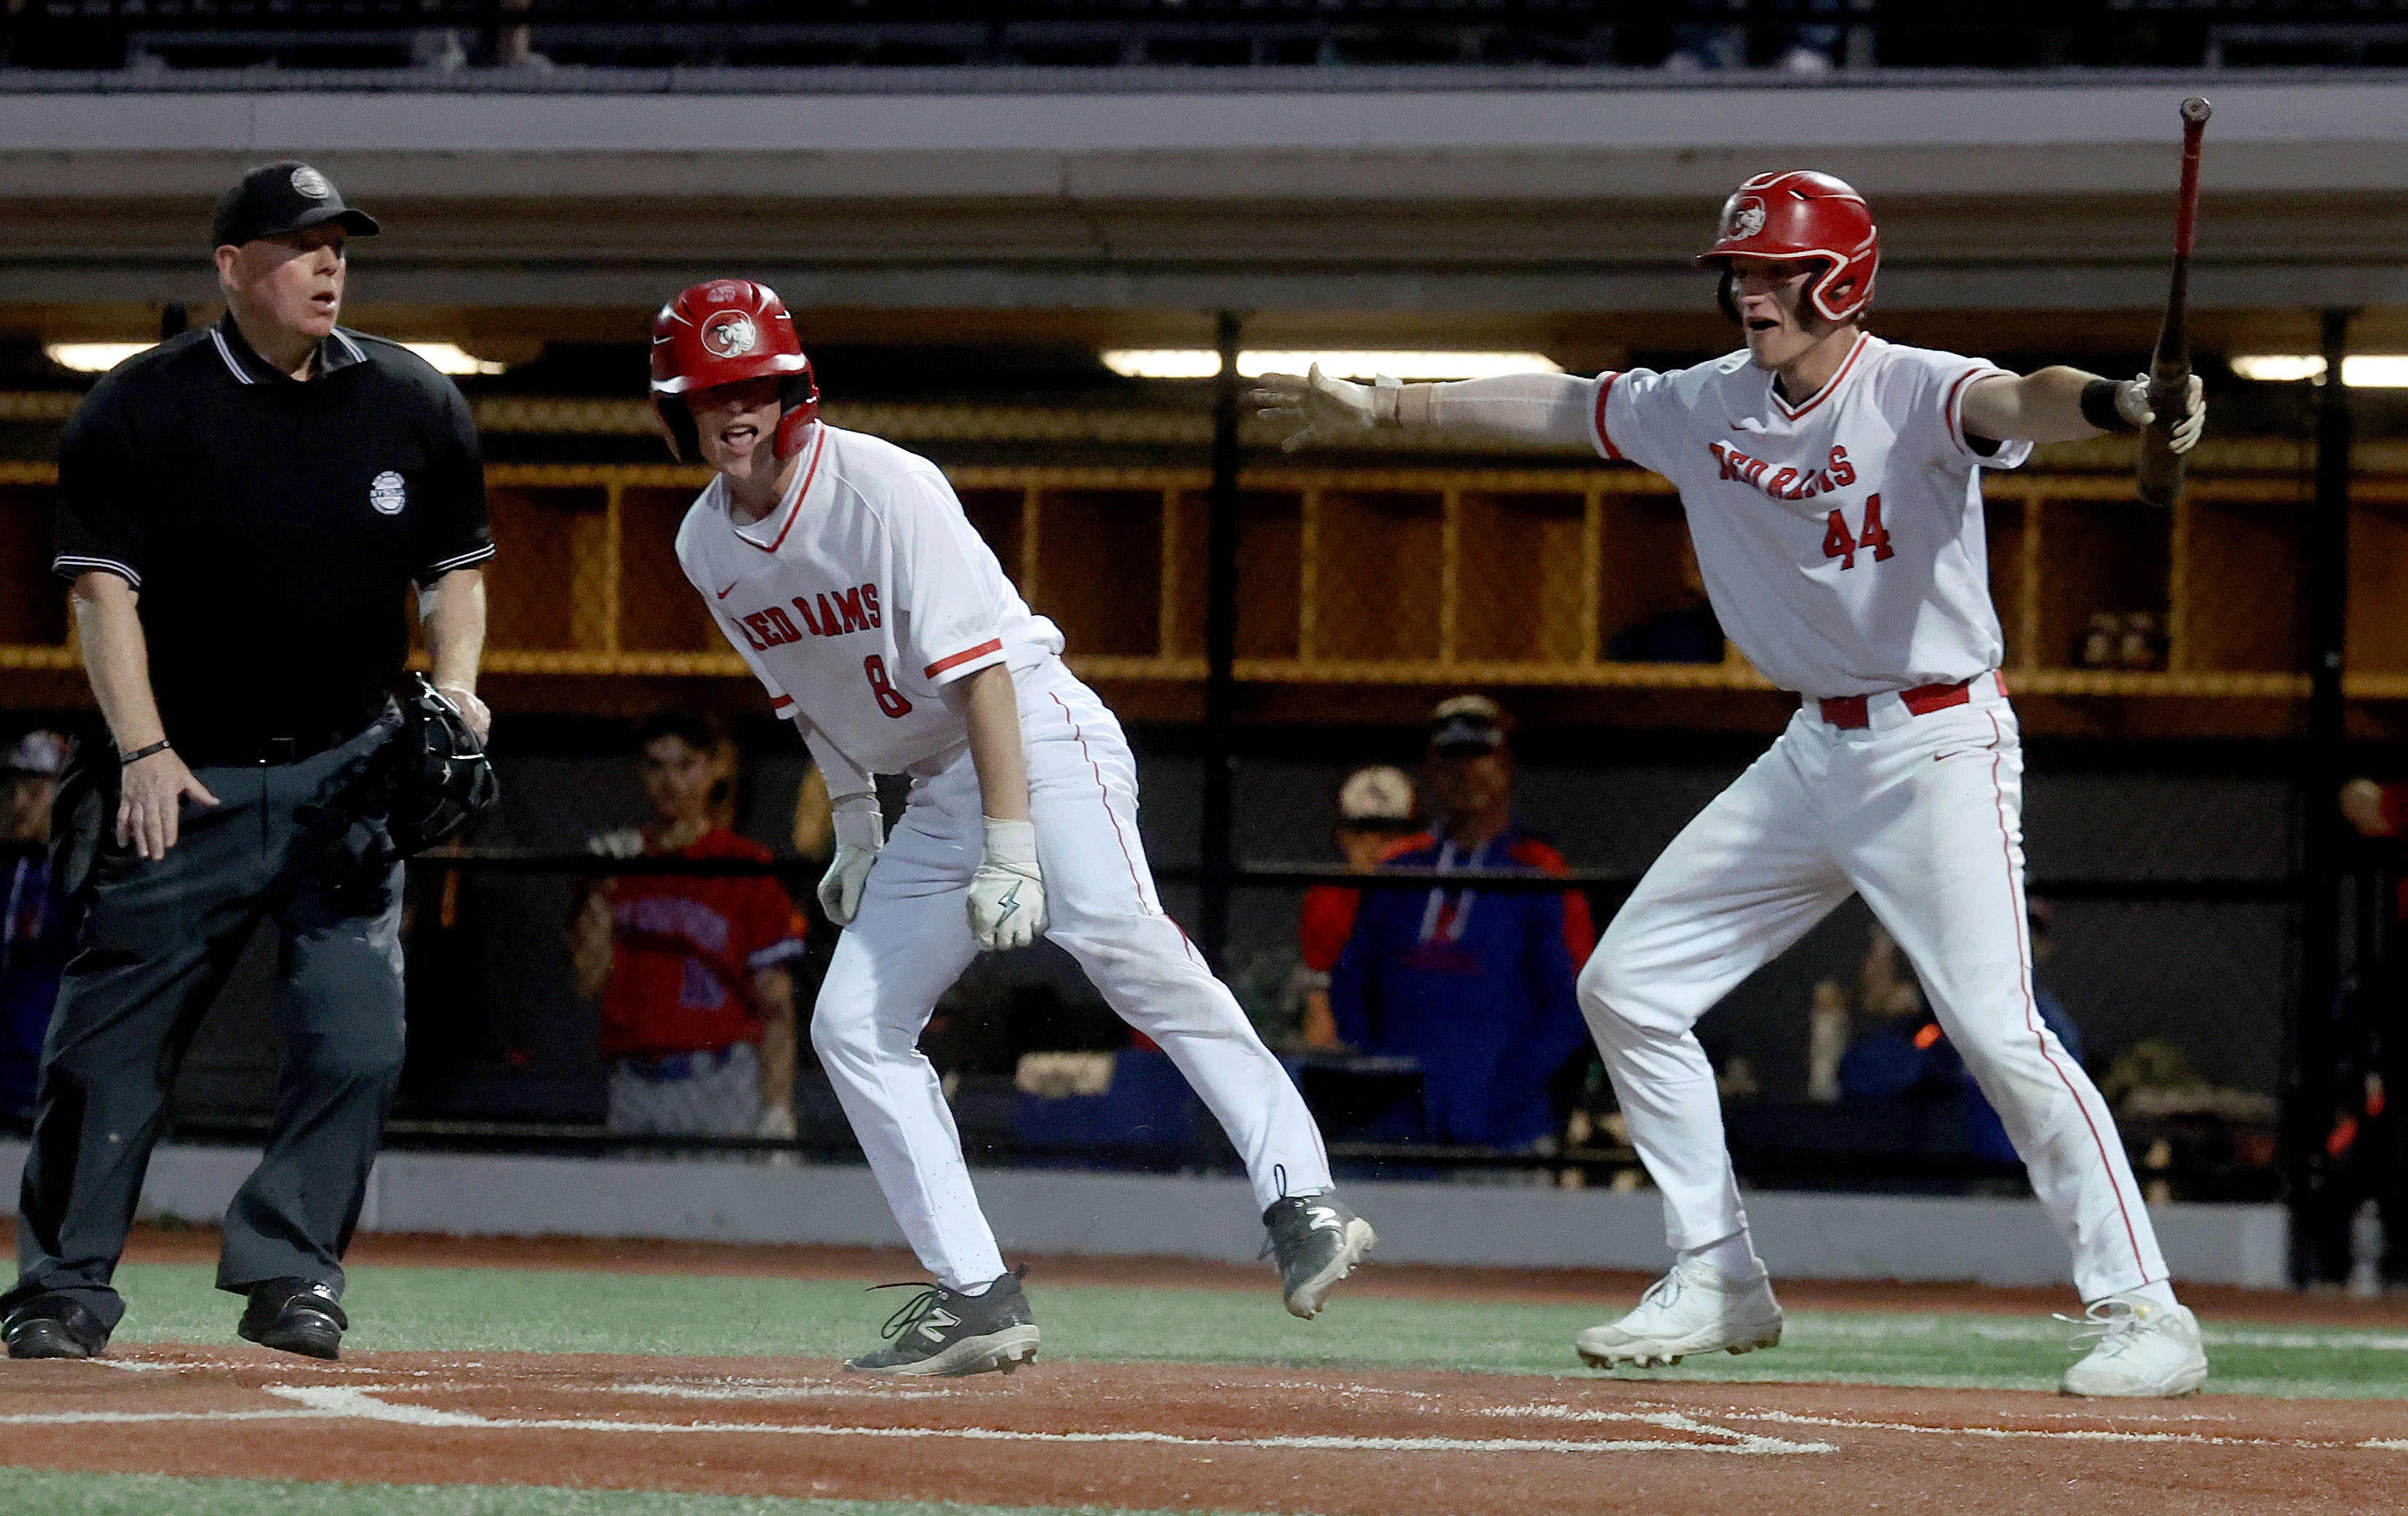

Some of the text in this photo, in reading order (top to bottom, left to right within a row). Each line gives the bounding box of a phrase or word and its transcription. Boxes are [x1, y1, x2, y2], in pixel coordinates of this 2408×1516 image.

[1822, 493, 1895, 571] 44
[731, 606, 803, 651] ED
[864, 654, 913, 718] 8
